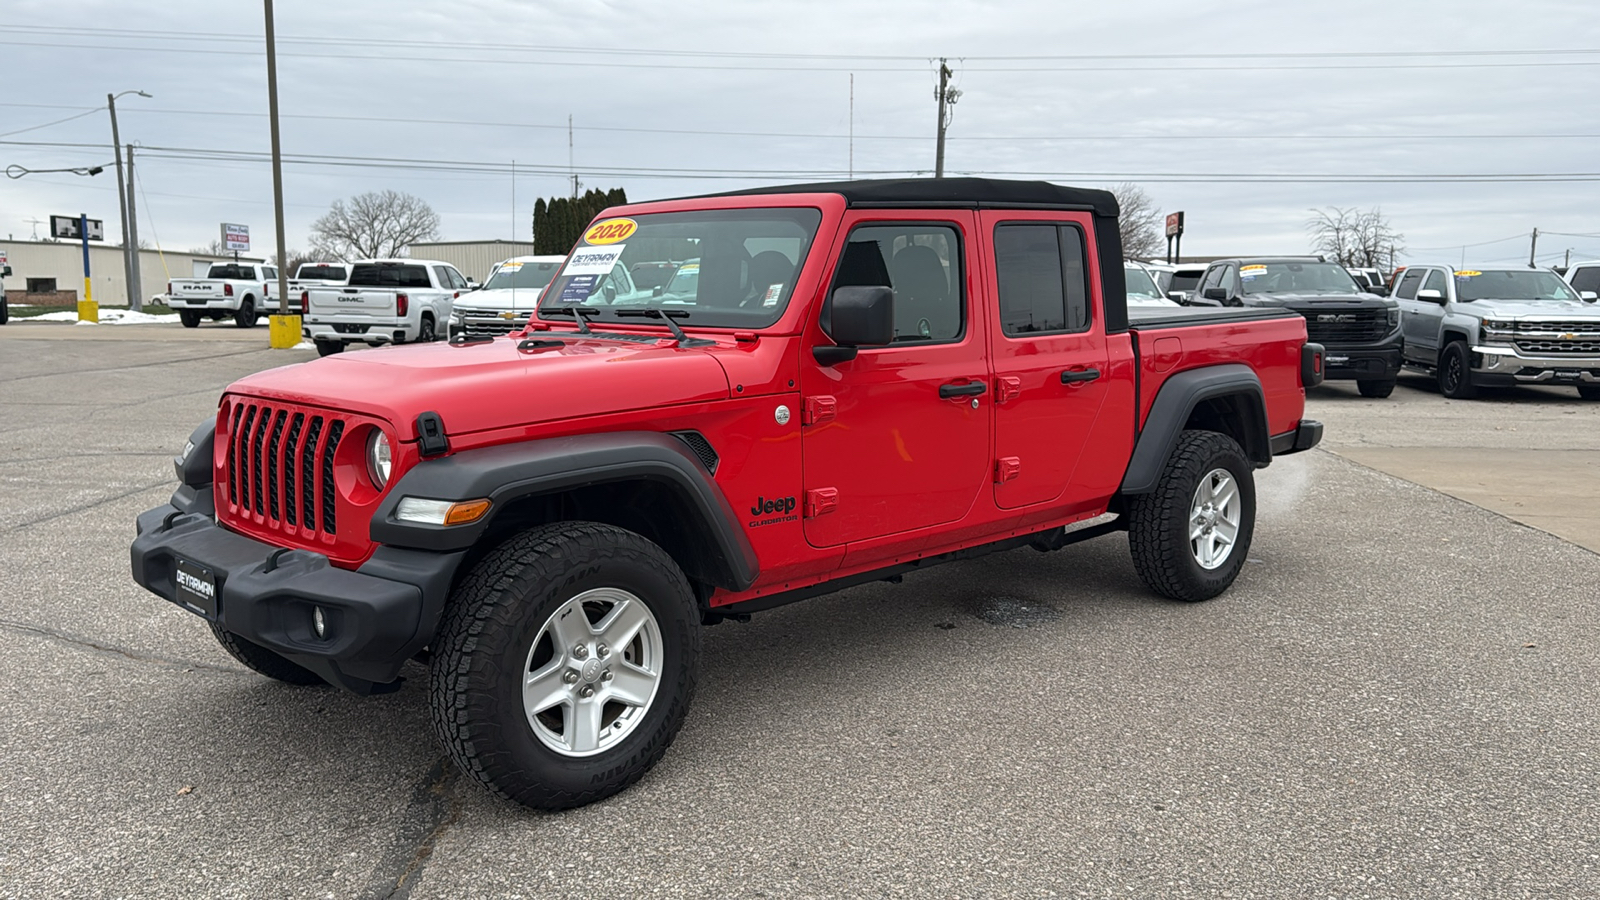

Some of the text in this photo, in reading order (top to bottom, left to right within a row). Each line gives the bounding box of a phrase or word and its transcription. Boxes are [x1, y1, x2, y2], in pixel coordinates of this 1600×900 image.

[588, 223, 633, 240] 2020
[572, 253, 618, 263] DEYARMAN
[1317, 314, 1356, 322] GMC
[751, 496, 796, 516] Jeep
[749, 515, 798, 528] GLADIATOR
[176, 569, 214, 597] DEYARMAN
[590, 696, 681, 786] MOUNTAIN
